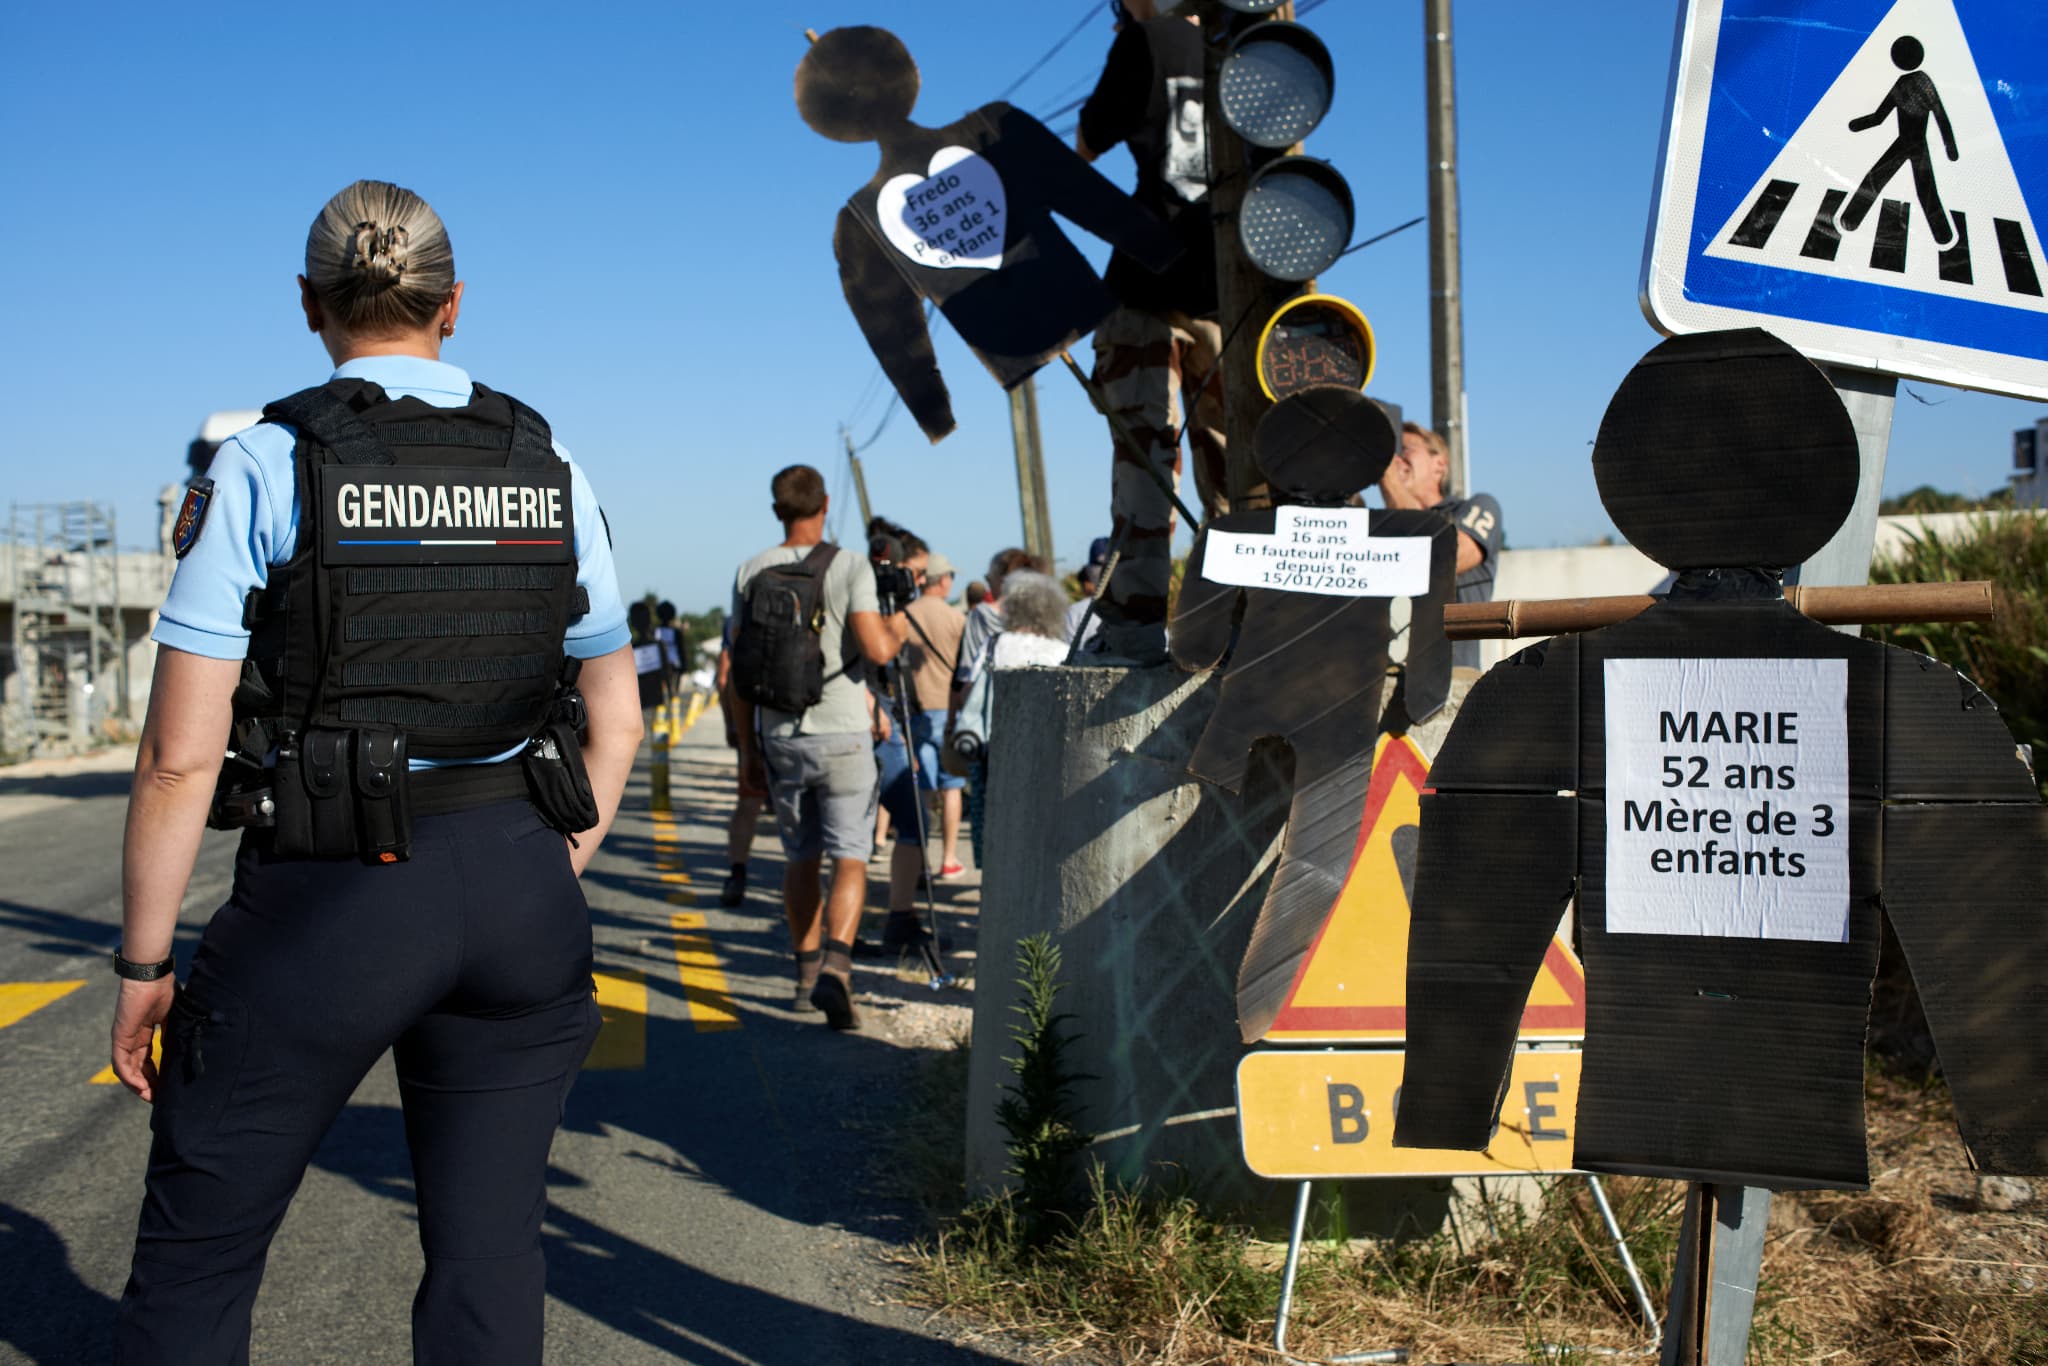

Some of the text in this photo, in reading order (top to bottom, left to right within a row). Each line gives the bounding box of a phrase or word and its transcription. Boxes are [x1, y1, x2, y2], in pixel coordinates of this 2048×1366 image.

[907, 175, 960, 211] Fredo
[914, 190, 976, 233] 36 ans
[959, 211, 984, 231] de
[984, 200, 1000, 217] 1
[938, 225, 998, 264] enfant
[337, 483, 563, 529] GENDARMERIE
[1293, 516, 1347, 529] Simon
[1462, 505, 1495, 540] 12
[1235, 544, 1400, 563] En fauteuil roulant
[1291, 532, 1347, 545] 16 ans
[1263, 572, 1368, 589] 15/01/2026
[1276, 559, 1356, 575] depuis le
[1660, 711, 1798, 744] MARIE
[1662, 755, 1796, 790] 52 ans
[1624, 798, 1835, 837] Mère de 3
[1650, 840, 1807, 878] enfants
[1327, 1081, 1567, 1145] BE
